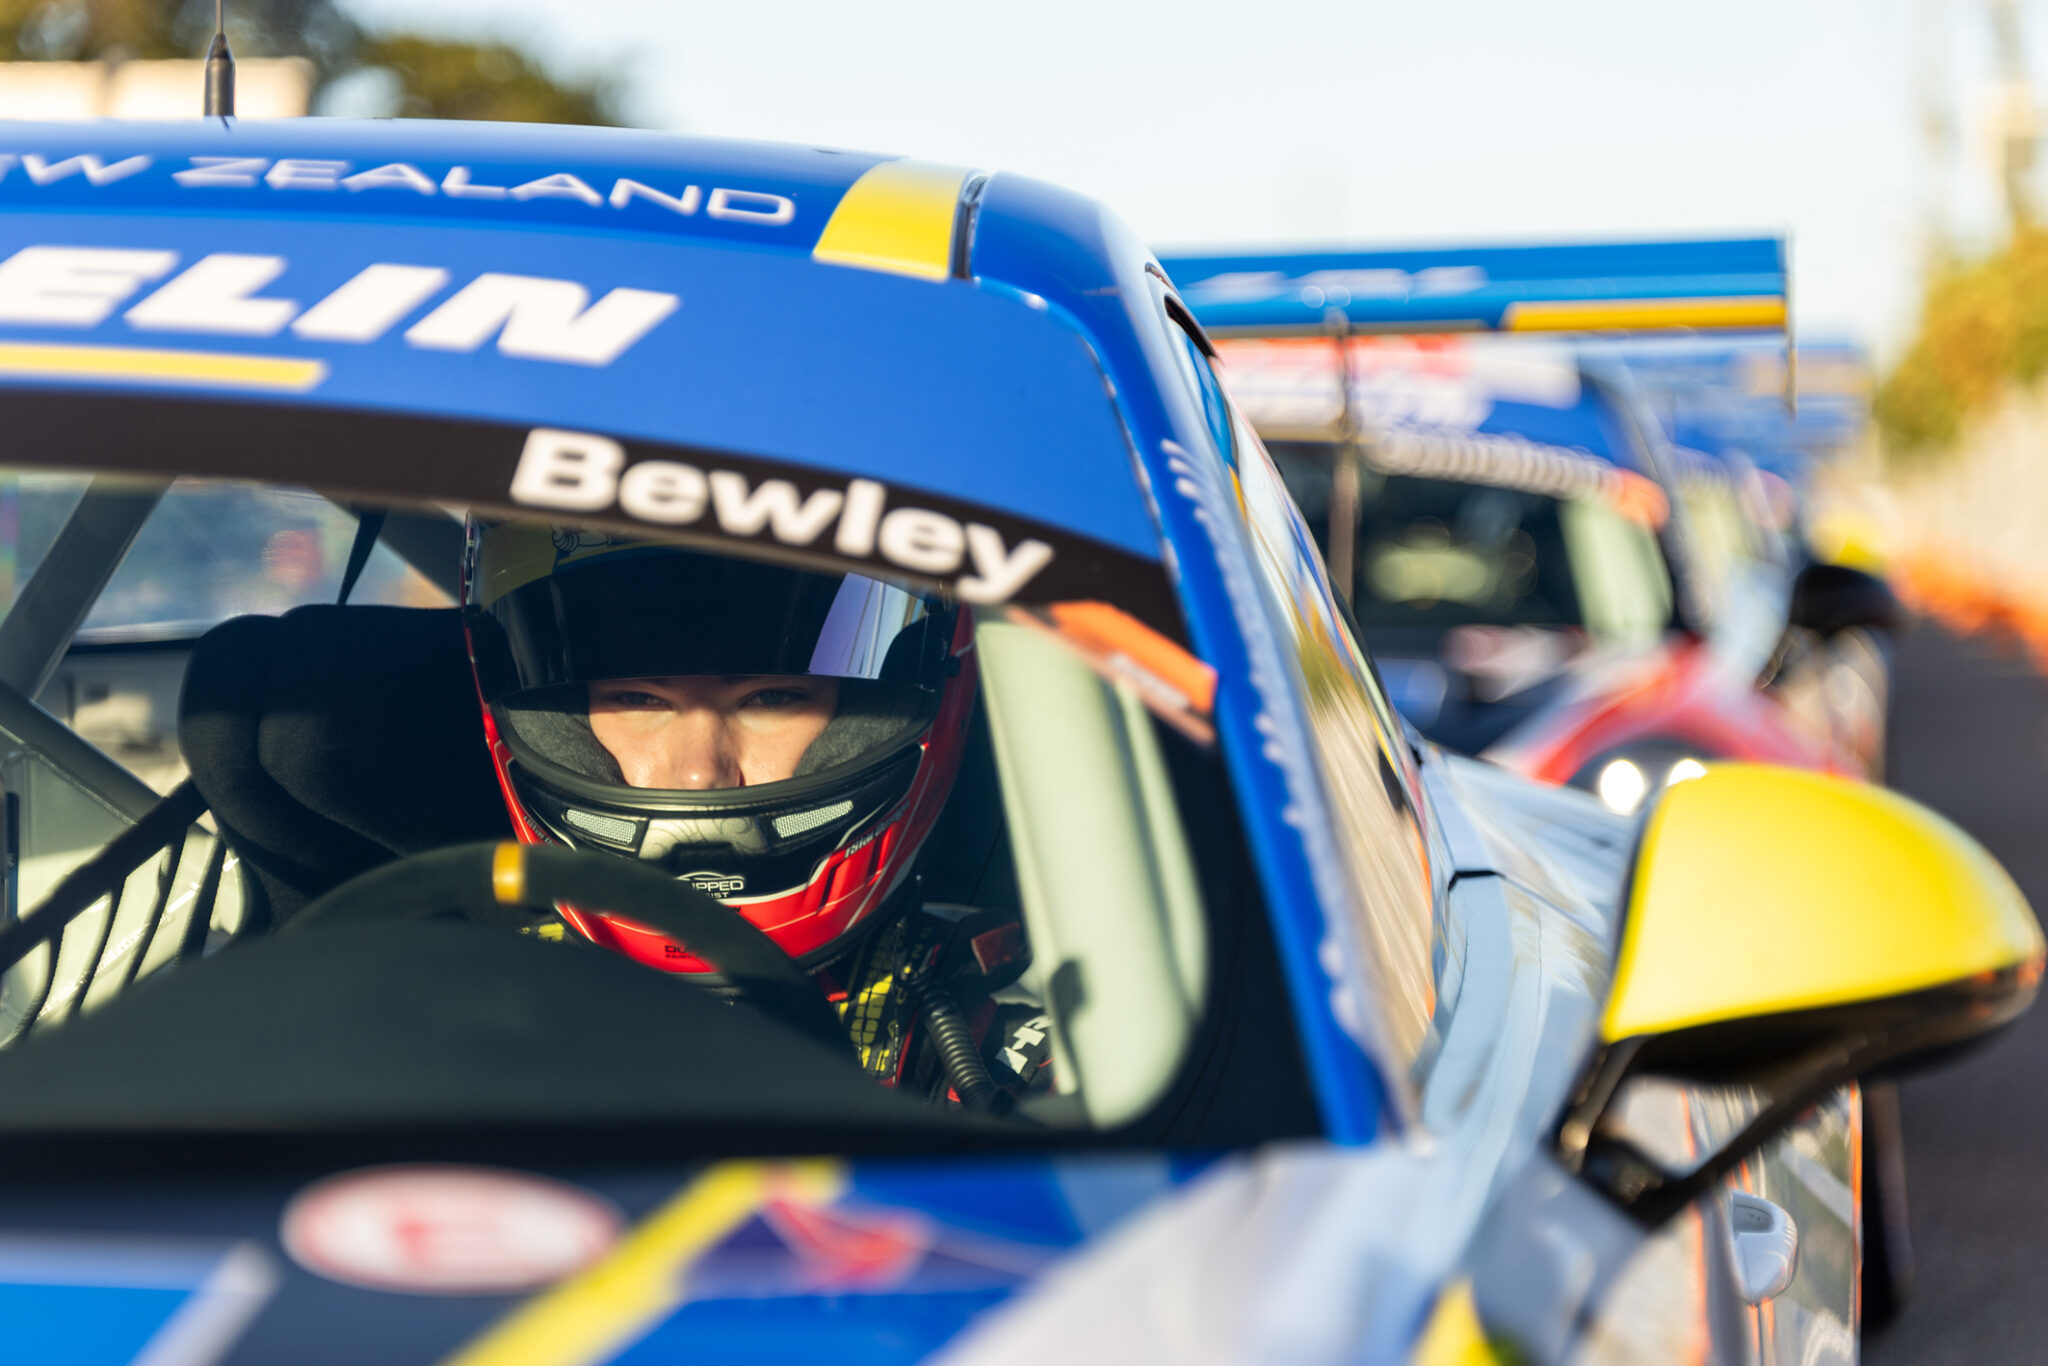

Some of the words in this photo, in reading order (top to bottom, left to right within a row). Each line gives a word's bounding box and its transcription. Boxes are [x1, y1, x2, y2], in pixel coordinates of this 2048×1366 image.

[172, 156, 796, 226] ZEALAND
[0, 245, 681, 368] ELIN
[510, 427, 1054, 604] Bewley
